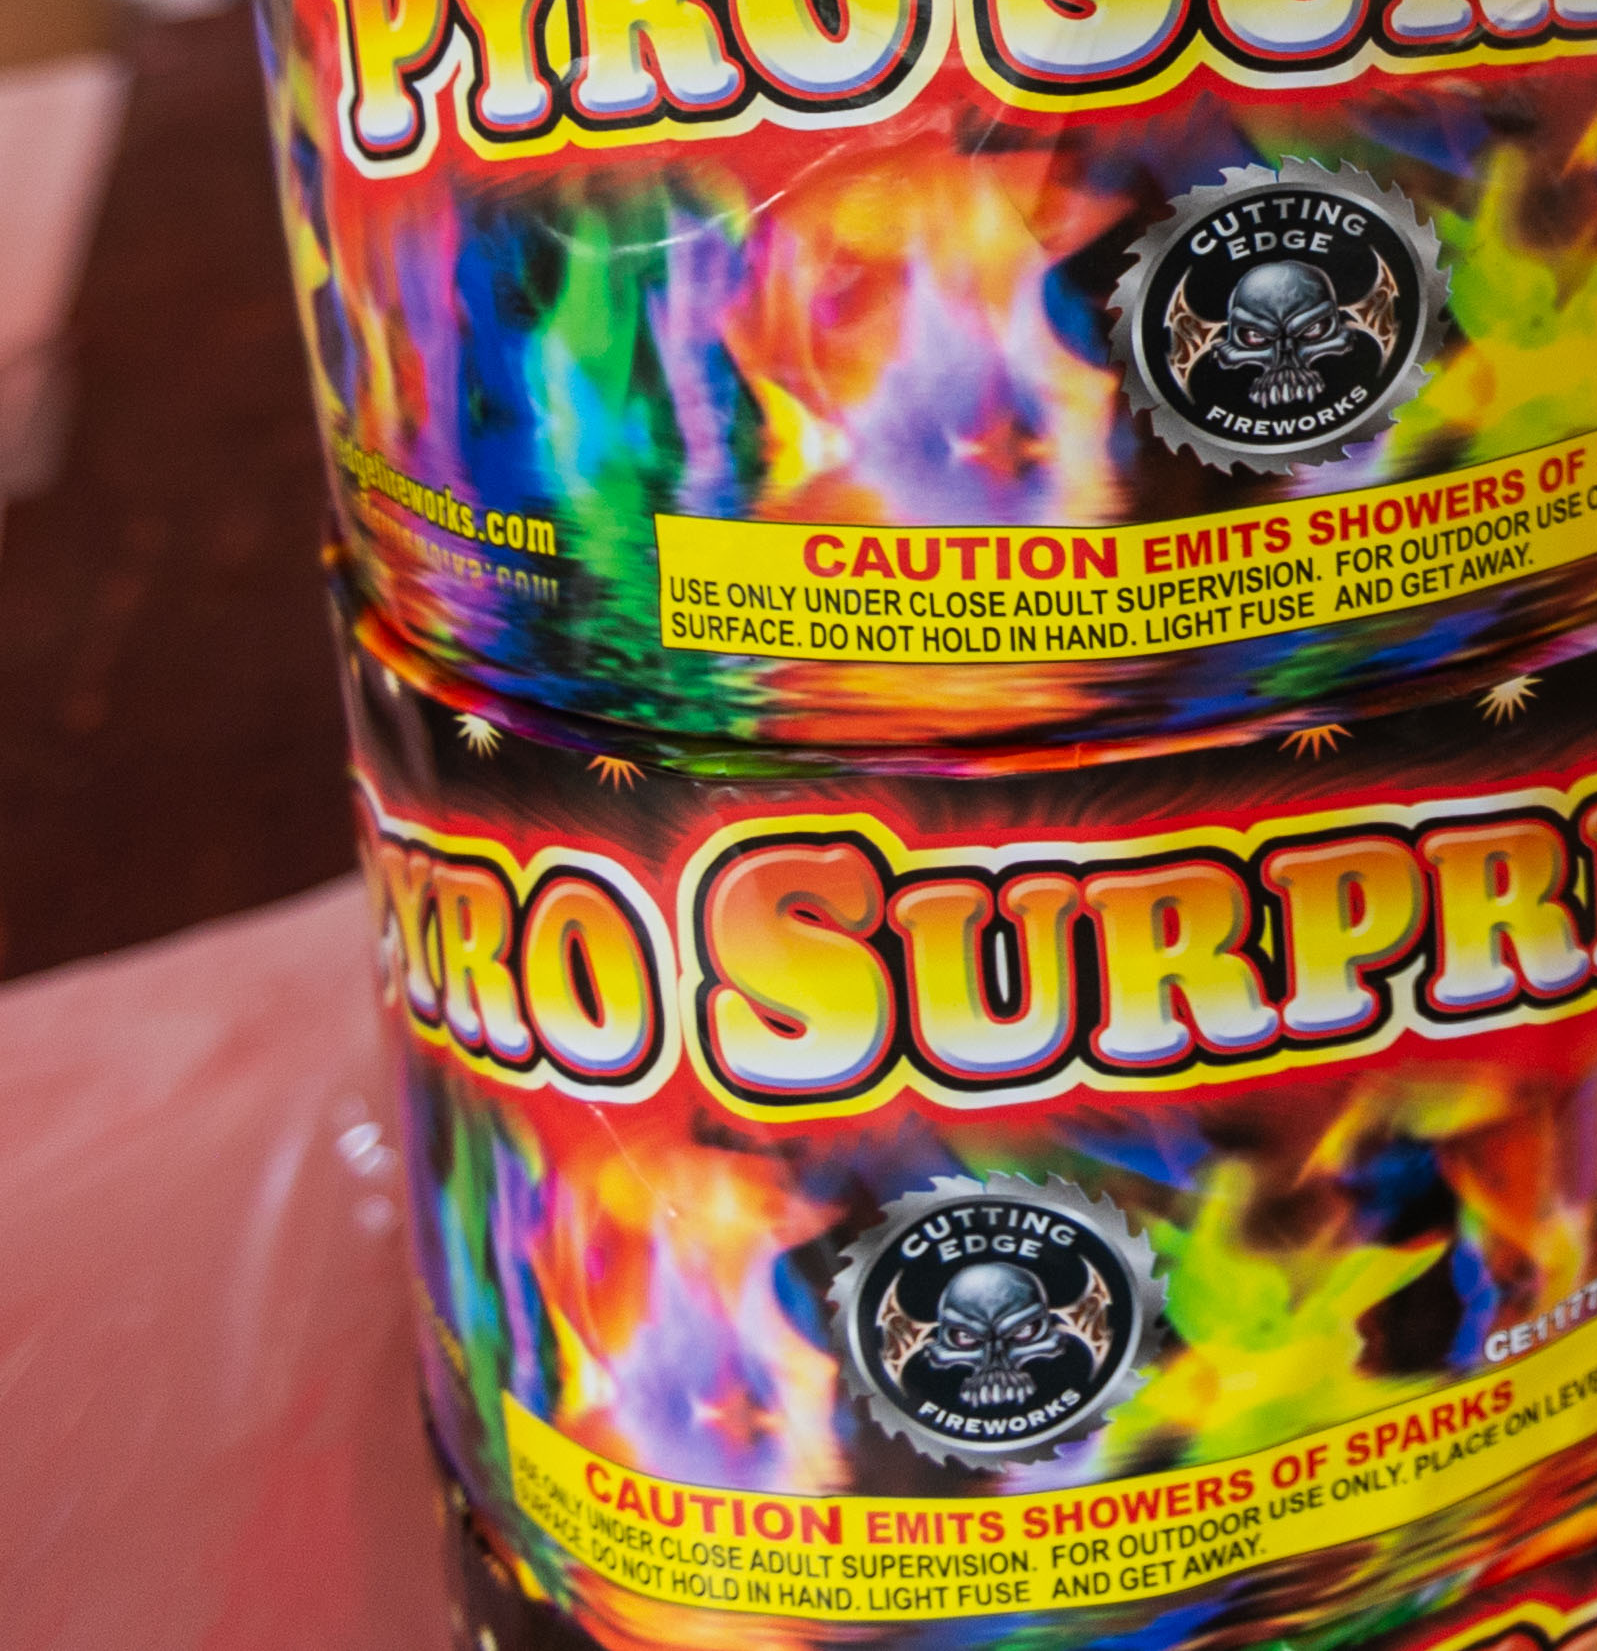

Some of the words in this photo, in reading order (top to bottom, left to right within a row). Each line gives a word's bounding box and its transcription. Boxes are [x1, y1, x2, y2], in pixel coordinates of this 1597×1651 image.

[1190, 198, 1367, 255] CUTTING
[1227, 230, 1333, 260] EDGE
[1205, 385, 1368, 436] FIREWORKS
[802, 533, 1119, 582] CAUTION
[1144, 517, 1291, 574] EMITS
[1308, 469, 1525, 546] SHOWERS
[1538, 448, 1586, 493] OF
[670, 576, 718, 607] USE
[727, 582, 797, 611] ONLY
[804, 586, 901, 616] UNDER
[909, 590, 1006, 618] CLOSE
[1013, 588, 1108, 617] ADULT
[1116, 556, 1322, 614] SUPERVISION.
[1336, 544, 1393, 577] FOR
[1400, 511, 1531, 564] OUTDOOR
[1536, 496, 1581, 530] USE
[671, 612, 802, 647] SURFACE.
[810, 622, 847, 650] DO
[857, 624, 914, 652] NOT
[923, 625, 1000, 653] HOLD
[1009, 625, 1036, 652] IN
[1045, 622, 1138, 651] HAND.
[1146, 607, 1233, 644] LIGHT
[1240, 592, 1314, 629] FUSE
[1335, 578, 1394, 612] AND
[1400, 564, 1455, 598] GET
[1459, 543, 1534, 586] AWAY.
[901, 1207, 1076, 1259] CUTTING
[940, 1234, 1042, 1263] EDGE
[918, 1388, 1081, 1435] FIREWORKS
[584, 1461, 843, 1545] CAUTION
[866, 1510, 1005, 1545] EMITS
[1022, 1469, 1255, 1540] SHOWERS
[1271, 1444, 1328, 1489] OF
[1346, 1380, 1516, 1466] SPARKS
[587, 1503, 653, 1556] UNDER
[660, 1536, 743, 1571] CLOSE
[750, 1549, 833, 1579] ADULT
[842, 1549, 1038, 1579] SUPERVISION.
[1052, 1538, 1109, 1568] FOR
[1118, 1505, 1260, 1560] OUTDOOR
[1269, 1485, 1324, 1521] USE
[1330, 1461, 1408, 1502] ONLY.
[1414, 1423, 1499, 1481] PLACE
[1504, 1408, 1540, 1437] ON
[591, 1539, 618, 1571] DO
[622, 1556, 664, 1589] NOT
[672, 1571, 740, 1601] HOLD
[748, 1580, 771, 1604] IN
[779, 1584, 861, 1612] HAND.
[869, 1585, 949, 1612] LIGHT
[958, 1580, 1031, 1607] FUSE
[1052, 1570, 1111, 1600] AND
[1119, 1560, 1173, 1591] GET
[1183, 1533, 1267, 1581] AWAY.
